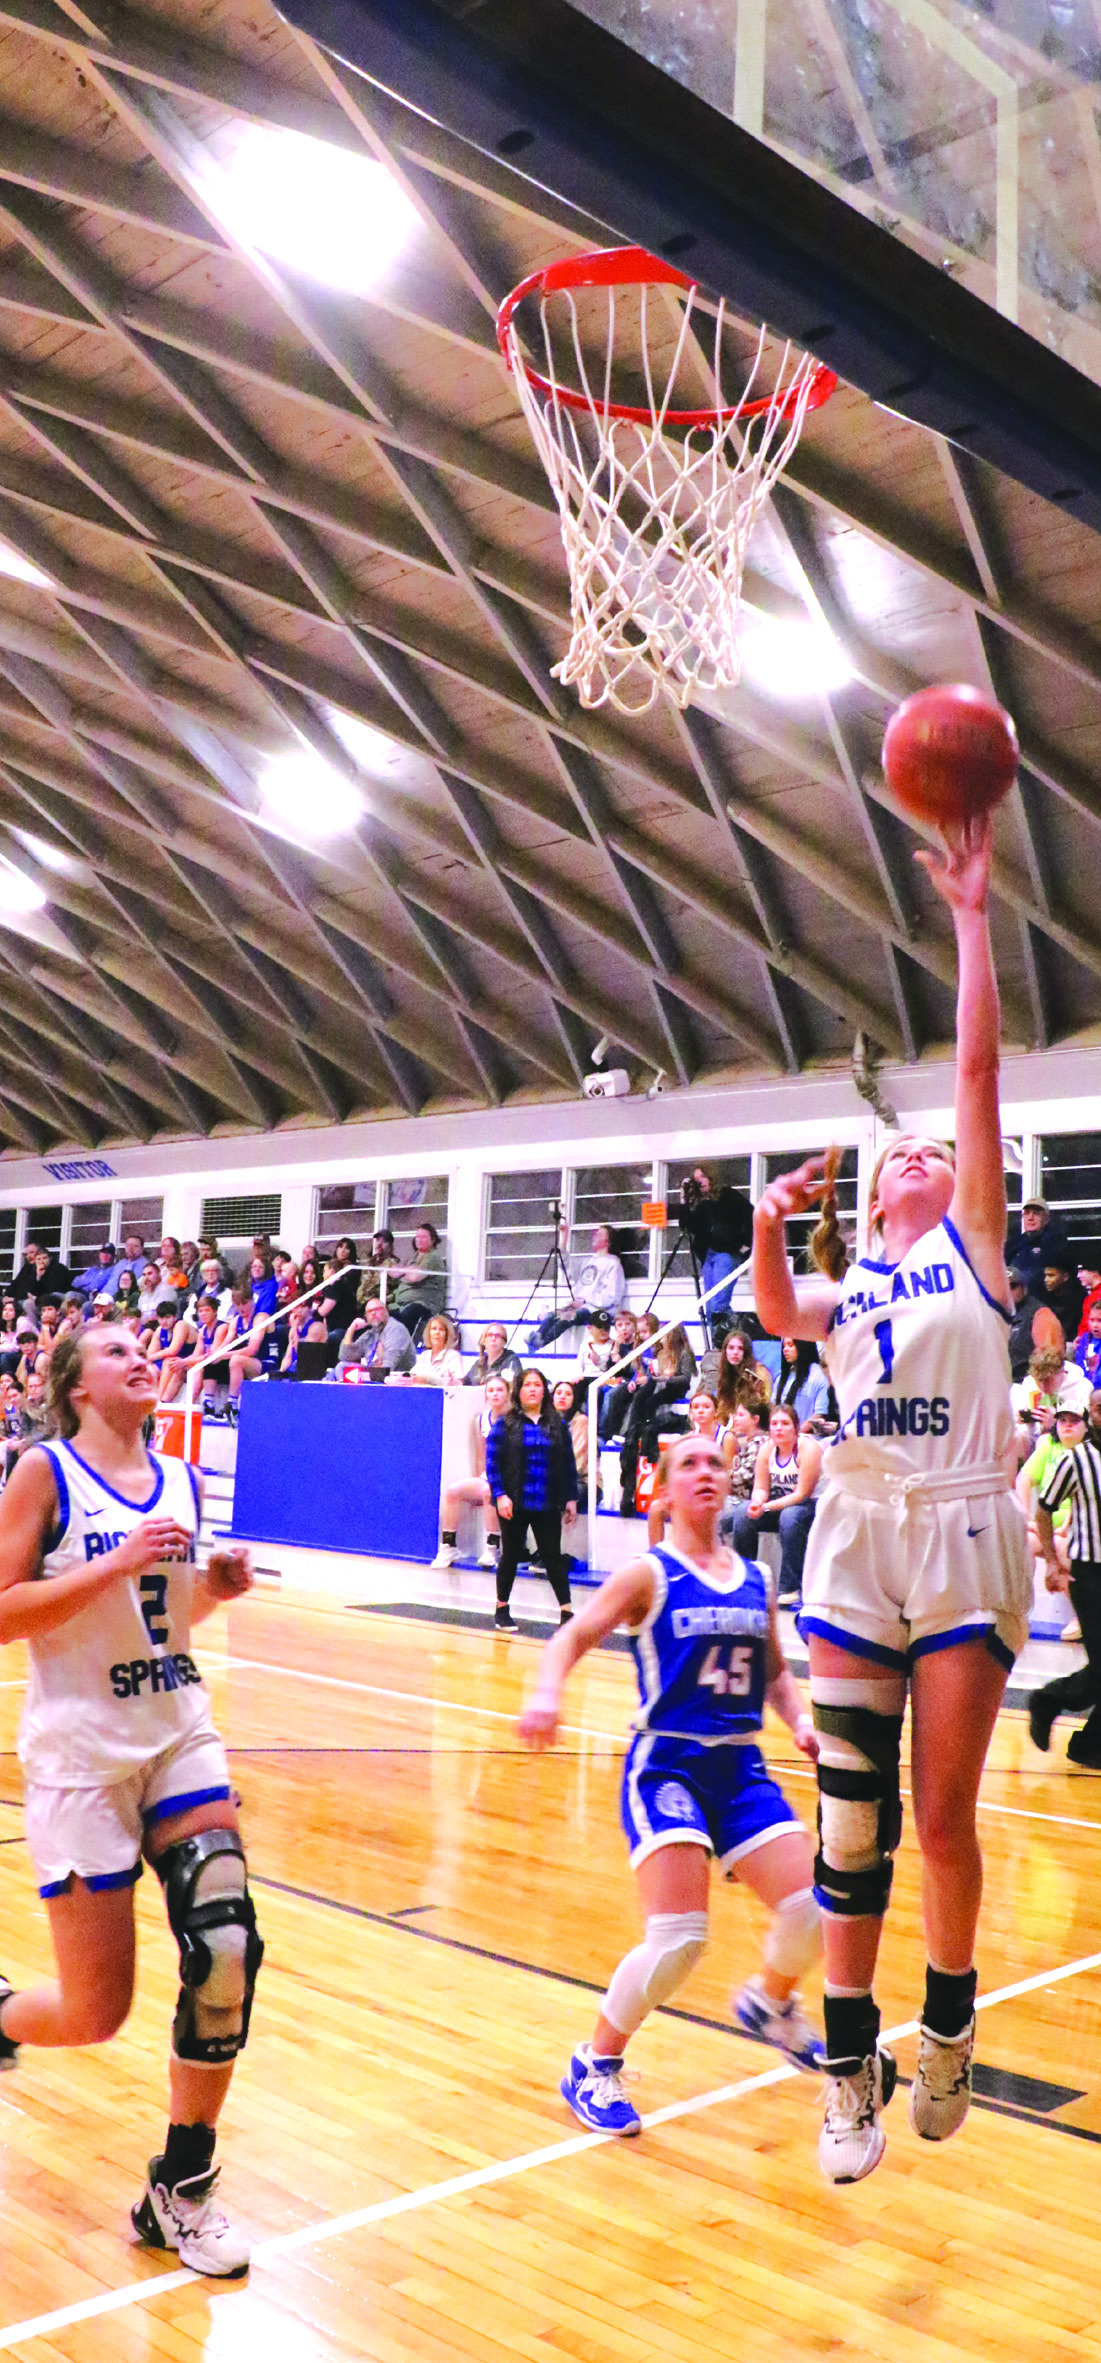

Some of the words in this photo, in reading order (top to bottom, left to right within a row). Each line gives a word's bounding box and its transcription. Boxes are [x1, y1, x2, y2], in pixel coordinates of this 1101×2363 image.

[42, 1160, 118, 1181] VISITOR
[874, 1319, 895, 1384] 1
[831, 1397, 950, 1446] RINGS
[140, 1575, 168, 1645] 2
[697, 1646, 753, 1696] 45
